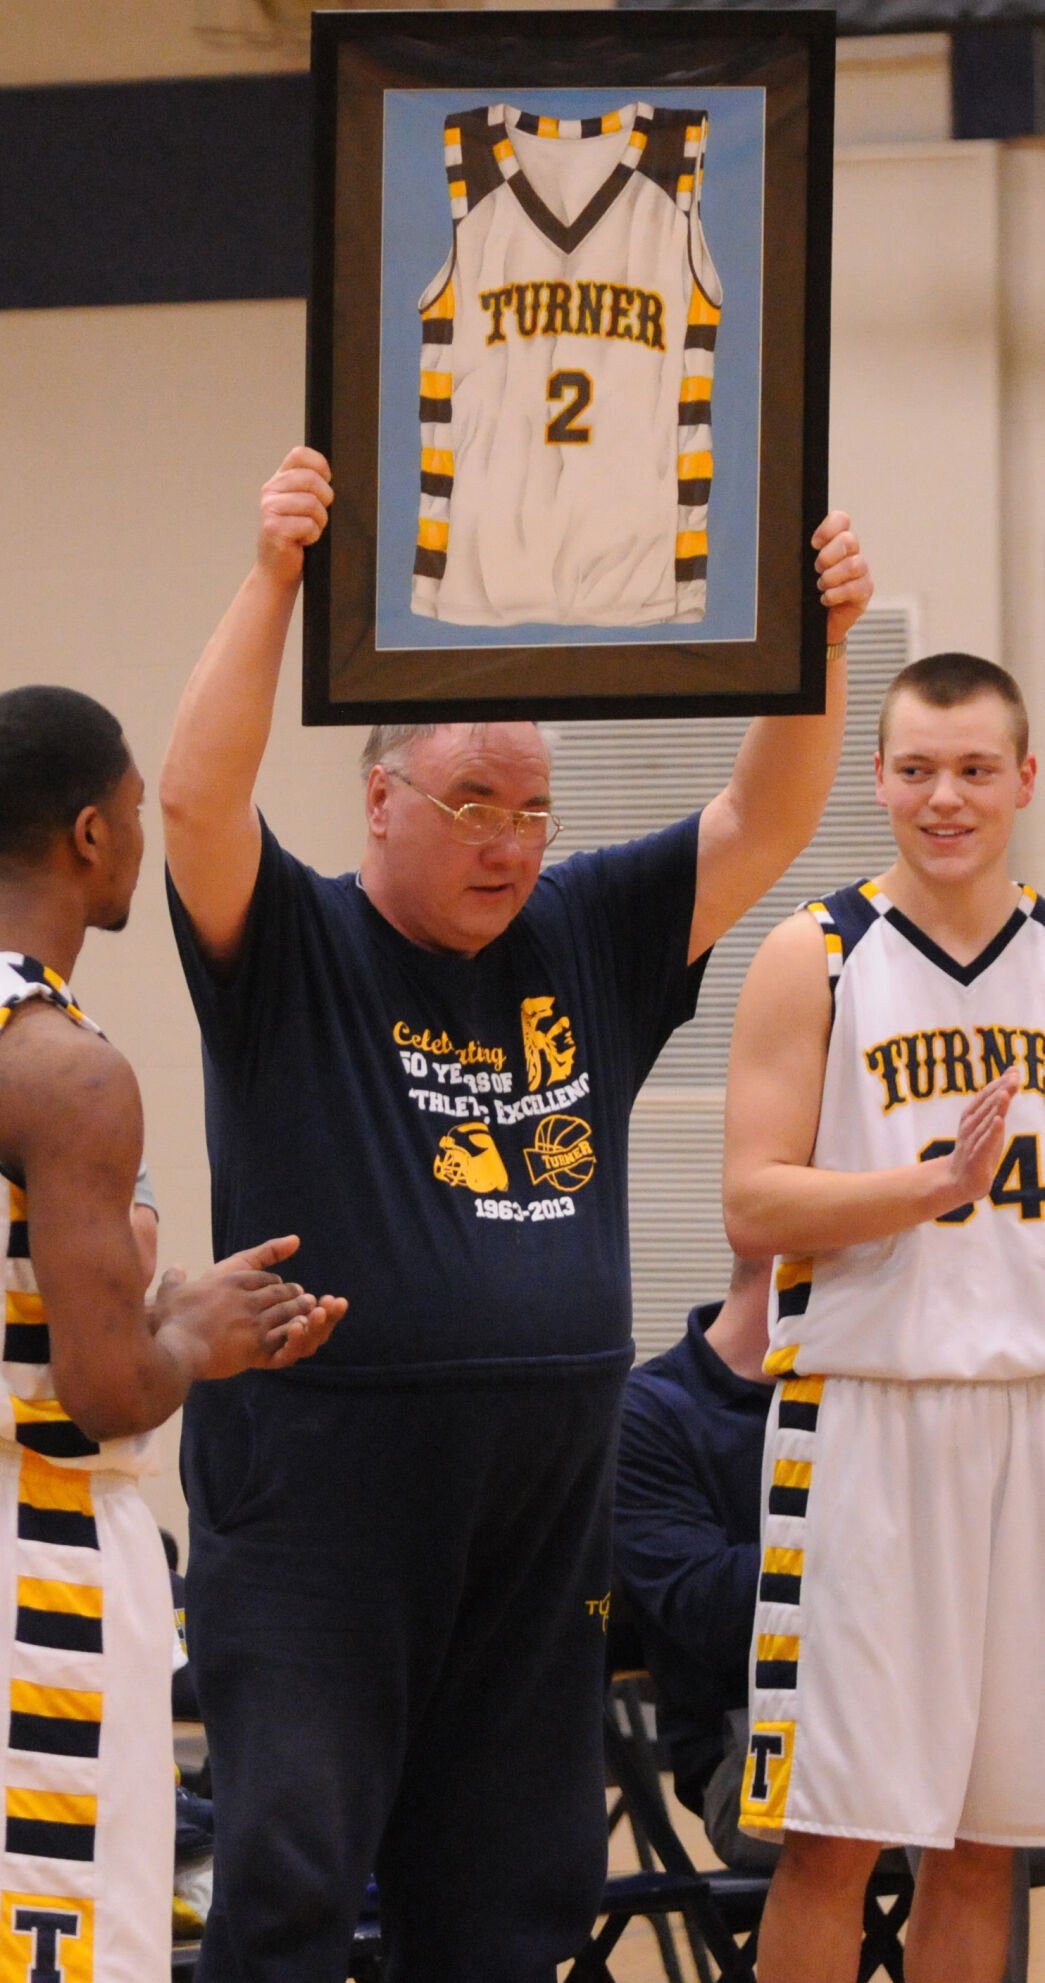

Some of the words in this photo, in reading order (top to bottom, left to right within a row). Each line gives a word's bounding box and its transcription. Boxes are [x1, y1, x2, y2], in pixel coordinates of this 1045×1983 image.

[479, 279, 667, 353] TURNER
[545, 367, 594, 446] 2
[393, 1020, 507, 1072] Celebating
[490, 1072, 512, 1093] OF
[541, 1140, 593, 1169] TURNER
[474, 1196, 576, 1222] 1963-2013
[748, 1731, 785, 1803] T
